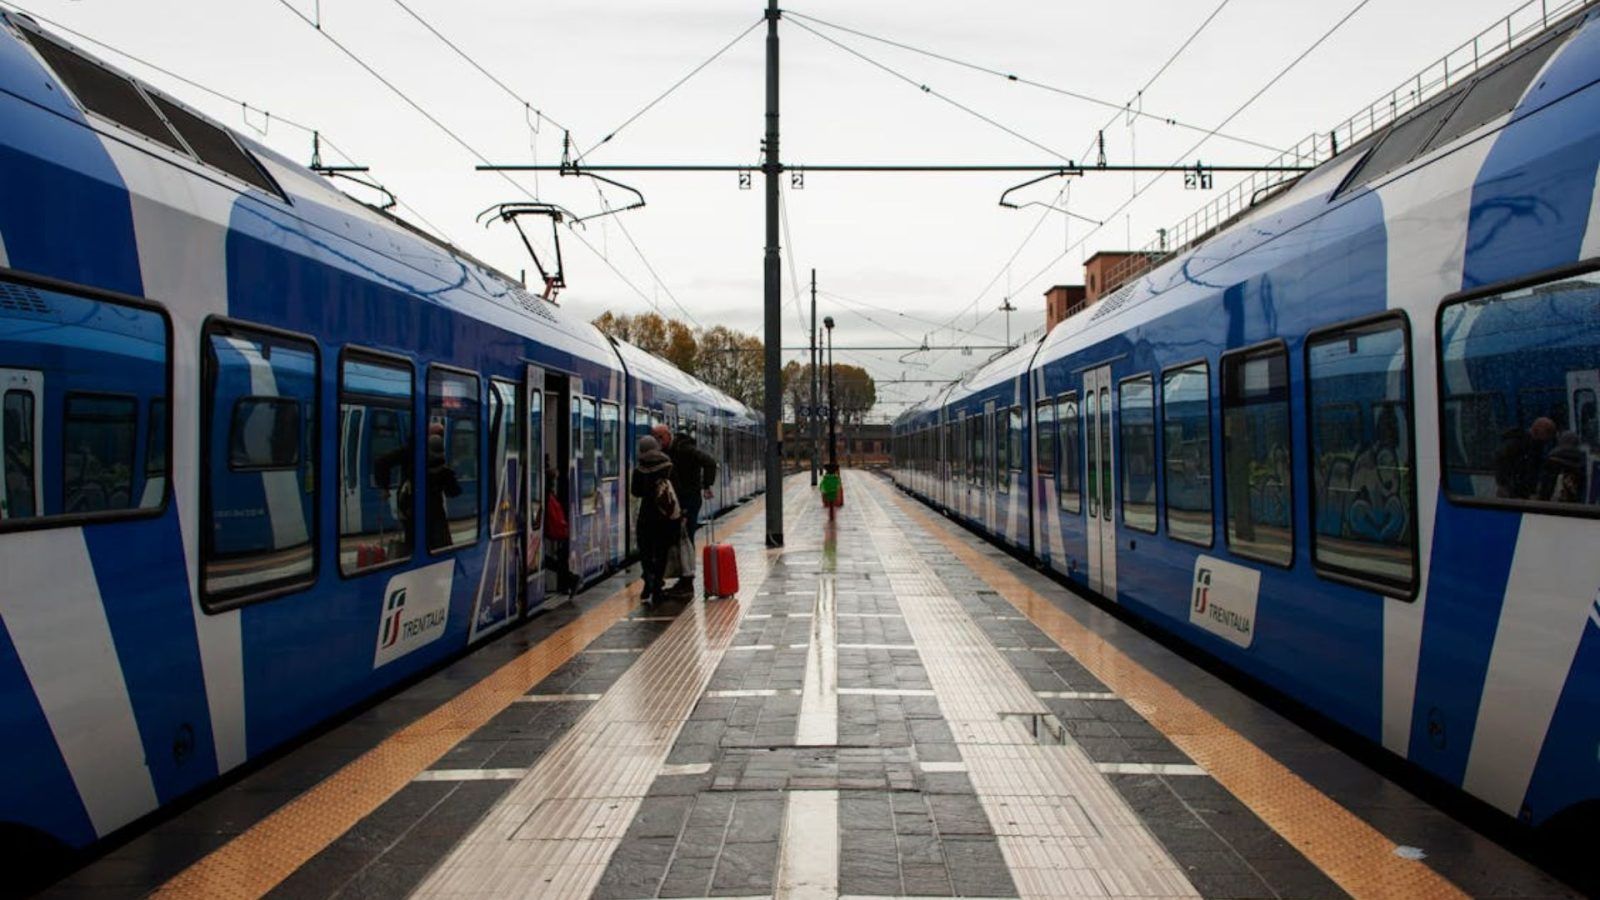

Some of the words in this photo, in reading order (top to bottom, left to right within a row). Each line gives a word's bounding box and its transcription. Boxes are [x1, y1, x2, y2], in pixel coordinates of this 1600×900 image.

[739, 173, 751, 188] 2
[792, 173, 803, 188] 2
[1185, 175, 1196, 189] 2
[403, 608, 445, 641] TRENITALIA
[1209, 603, 1250, 634] TRENITALIA
